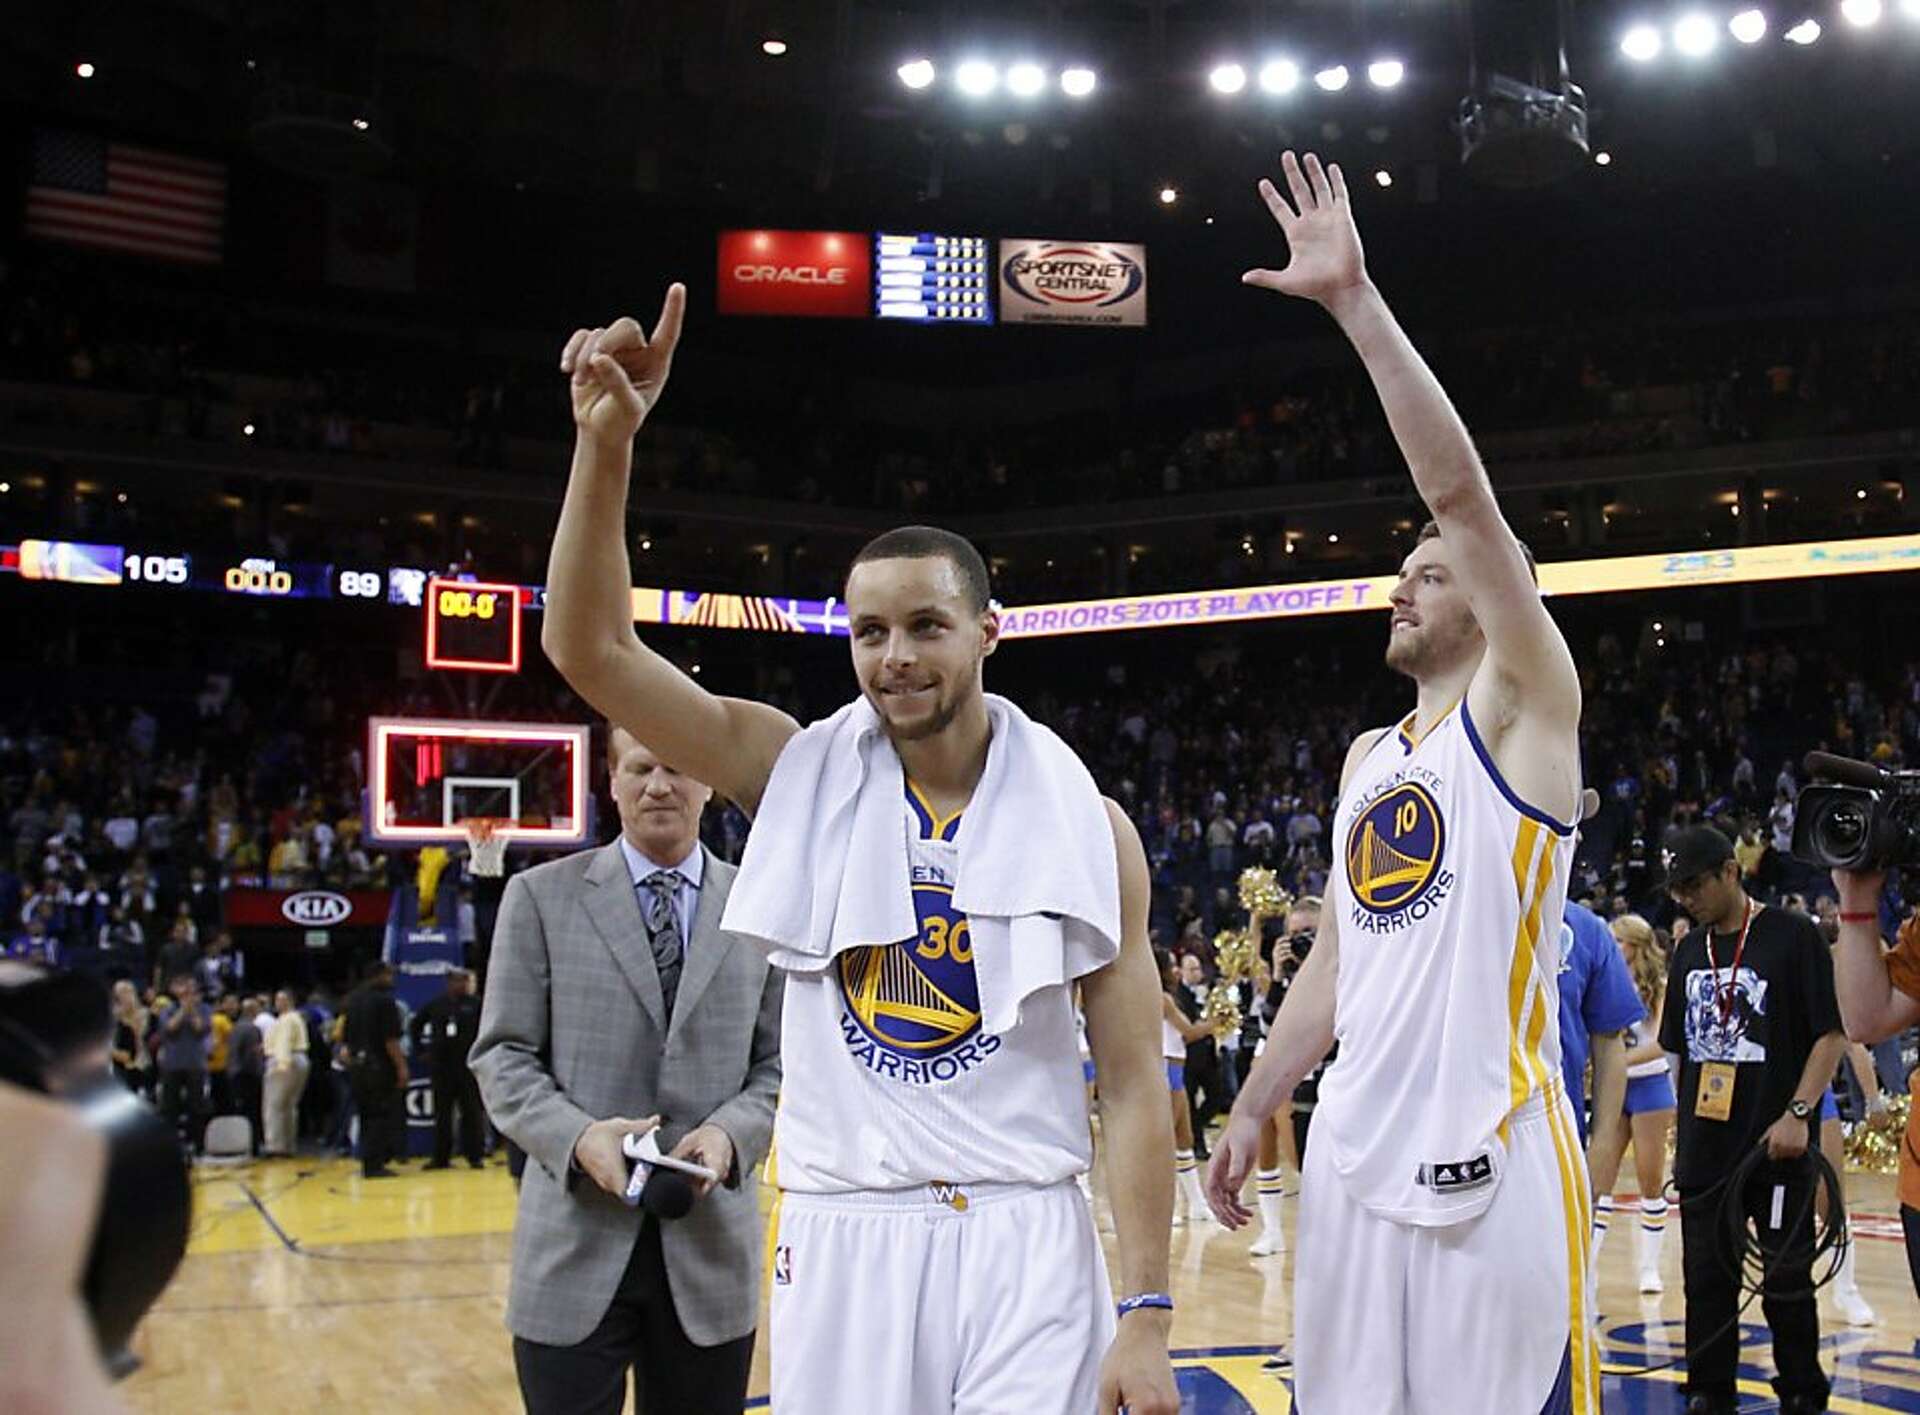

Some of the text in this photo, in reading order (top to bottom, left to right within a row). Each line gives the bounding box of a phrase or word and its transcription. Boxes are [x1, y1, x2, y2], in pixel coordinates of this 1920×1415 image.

[734, 265, 848, 284] ORACLE
[1014, 260, 1131, 278] SPORTSNET
[1035, 277, 1110, 290] CENTRAL
[124, 555, 187, 583] 105
[340, 571, 380, 597] 89
[998, 604, 1127, 633] ARRIORS
[1136, 598, 1200, 621] 2013
[1206, 586, 1344, 616] PLAYOFF
[1395, 800, 1418, 838] 10
[293, 896, 342, 919] KIA
[1351, 869, 1454, 934] WARRIORS
[916, 916, 973, 963] 30
[841, 1012, 1001, 1083] WARRIORS
